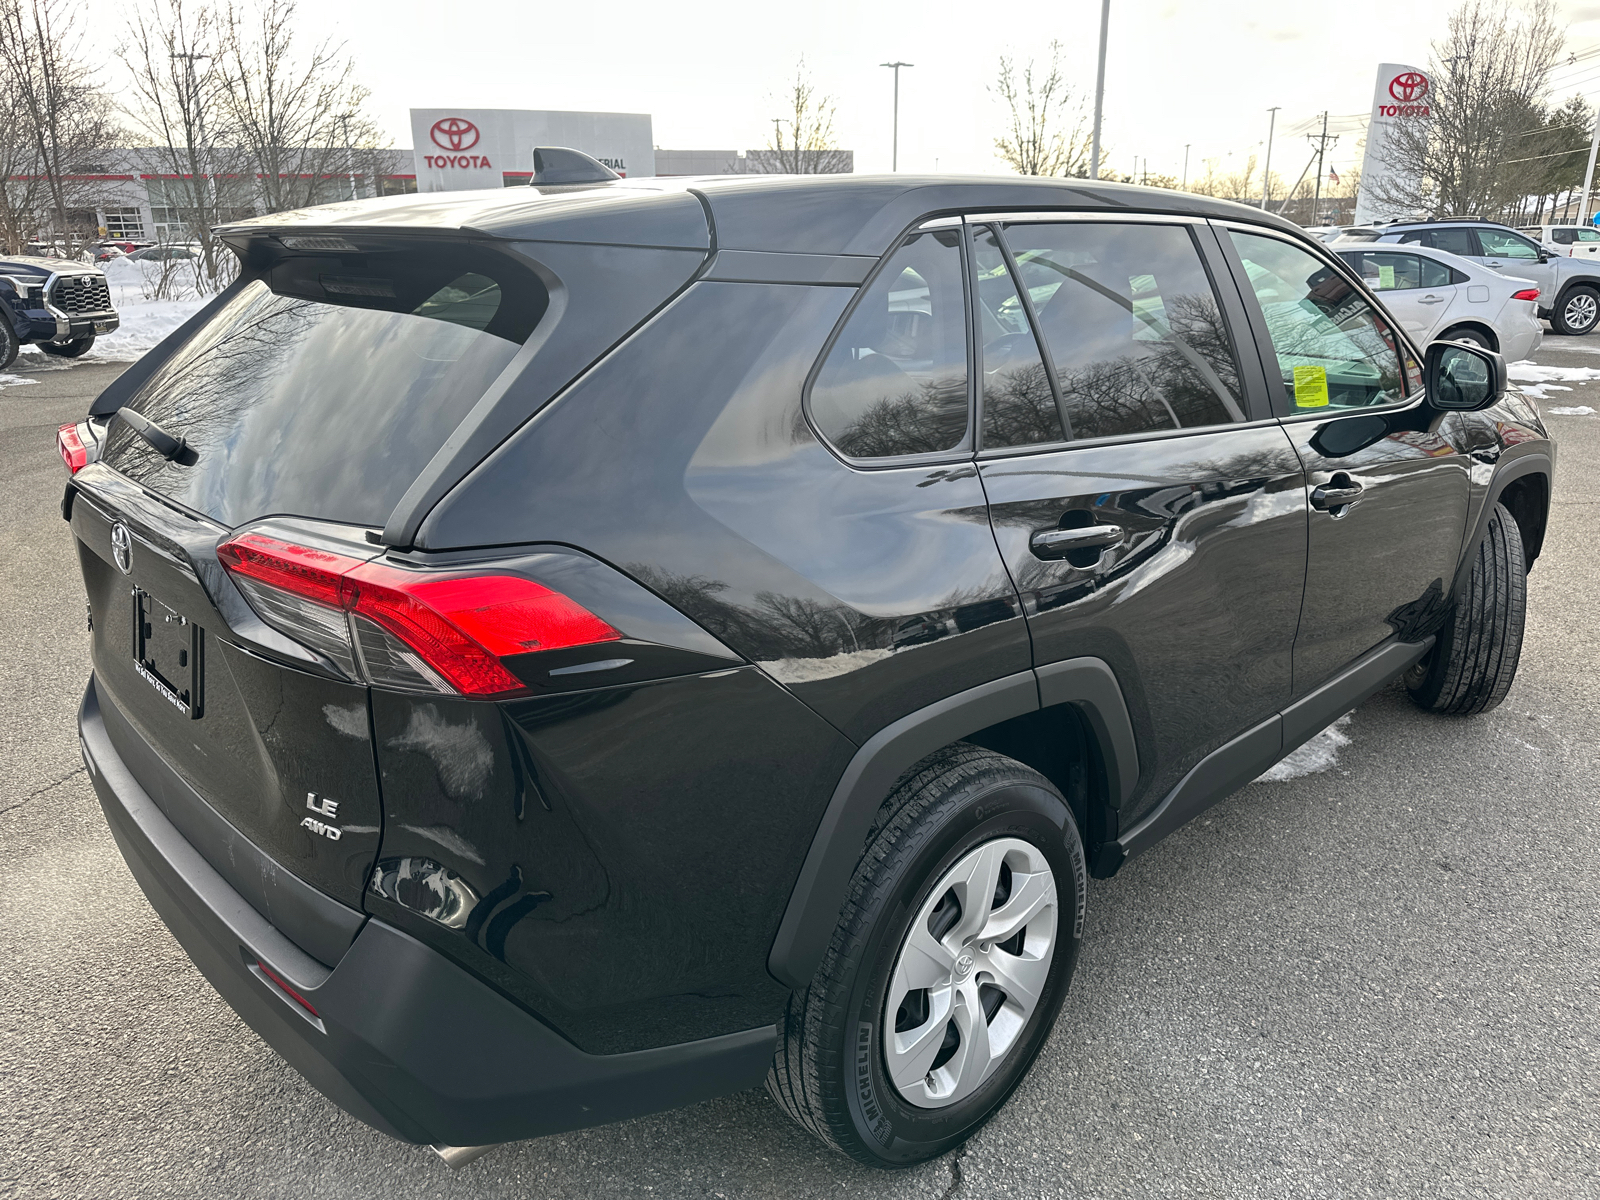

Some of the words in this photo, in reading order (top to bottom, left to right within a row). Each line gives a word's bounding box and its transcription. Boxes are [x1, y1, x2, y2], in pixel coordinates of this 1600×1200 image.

[1378, 105, 1430, 117] TOYOTA
[424, 155, 492, 169] TOYOTA
[306, 792, 340, 819] LE
[299, 817, 342, 841] AWD
[1072, 851, 1085, 934] MICHELIN
[858, 1027, 880, 1122] MICHELIN
